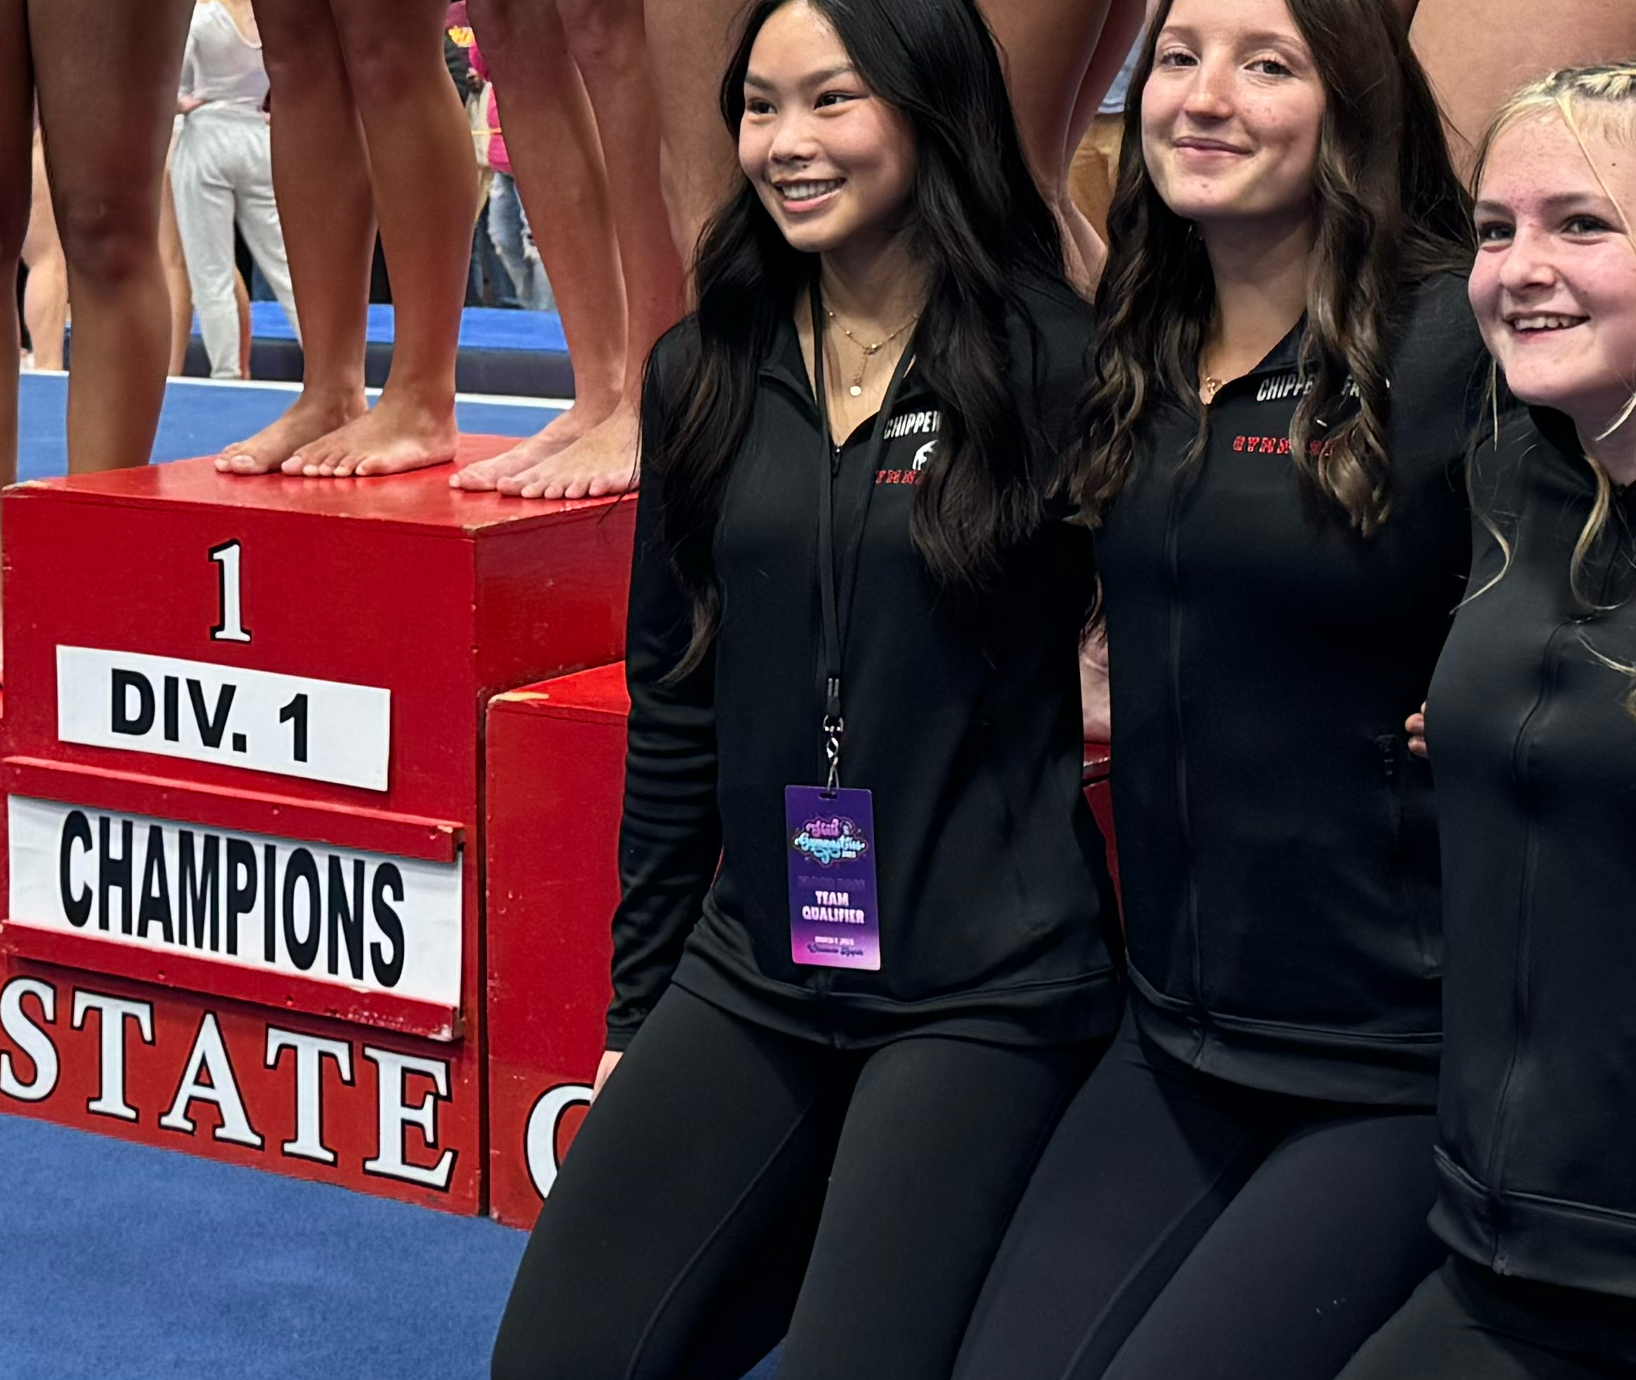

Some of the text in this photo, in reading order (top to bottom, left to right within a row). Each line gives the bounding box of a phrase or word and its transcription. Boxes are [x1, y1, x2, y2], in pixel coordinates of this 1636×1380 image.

[209, 538, 253, 643] 1
[110, 668, 309, 763] DIV. 1
[60, 809, 405, 988] CHAMPIONS
[801, 906, 865, 925] QUALIFIER
[815, 890, 850, 907] TEAM
